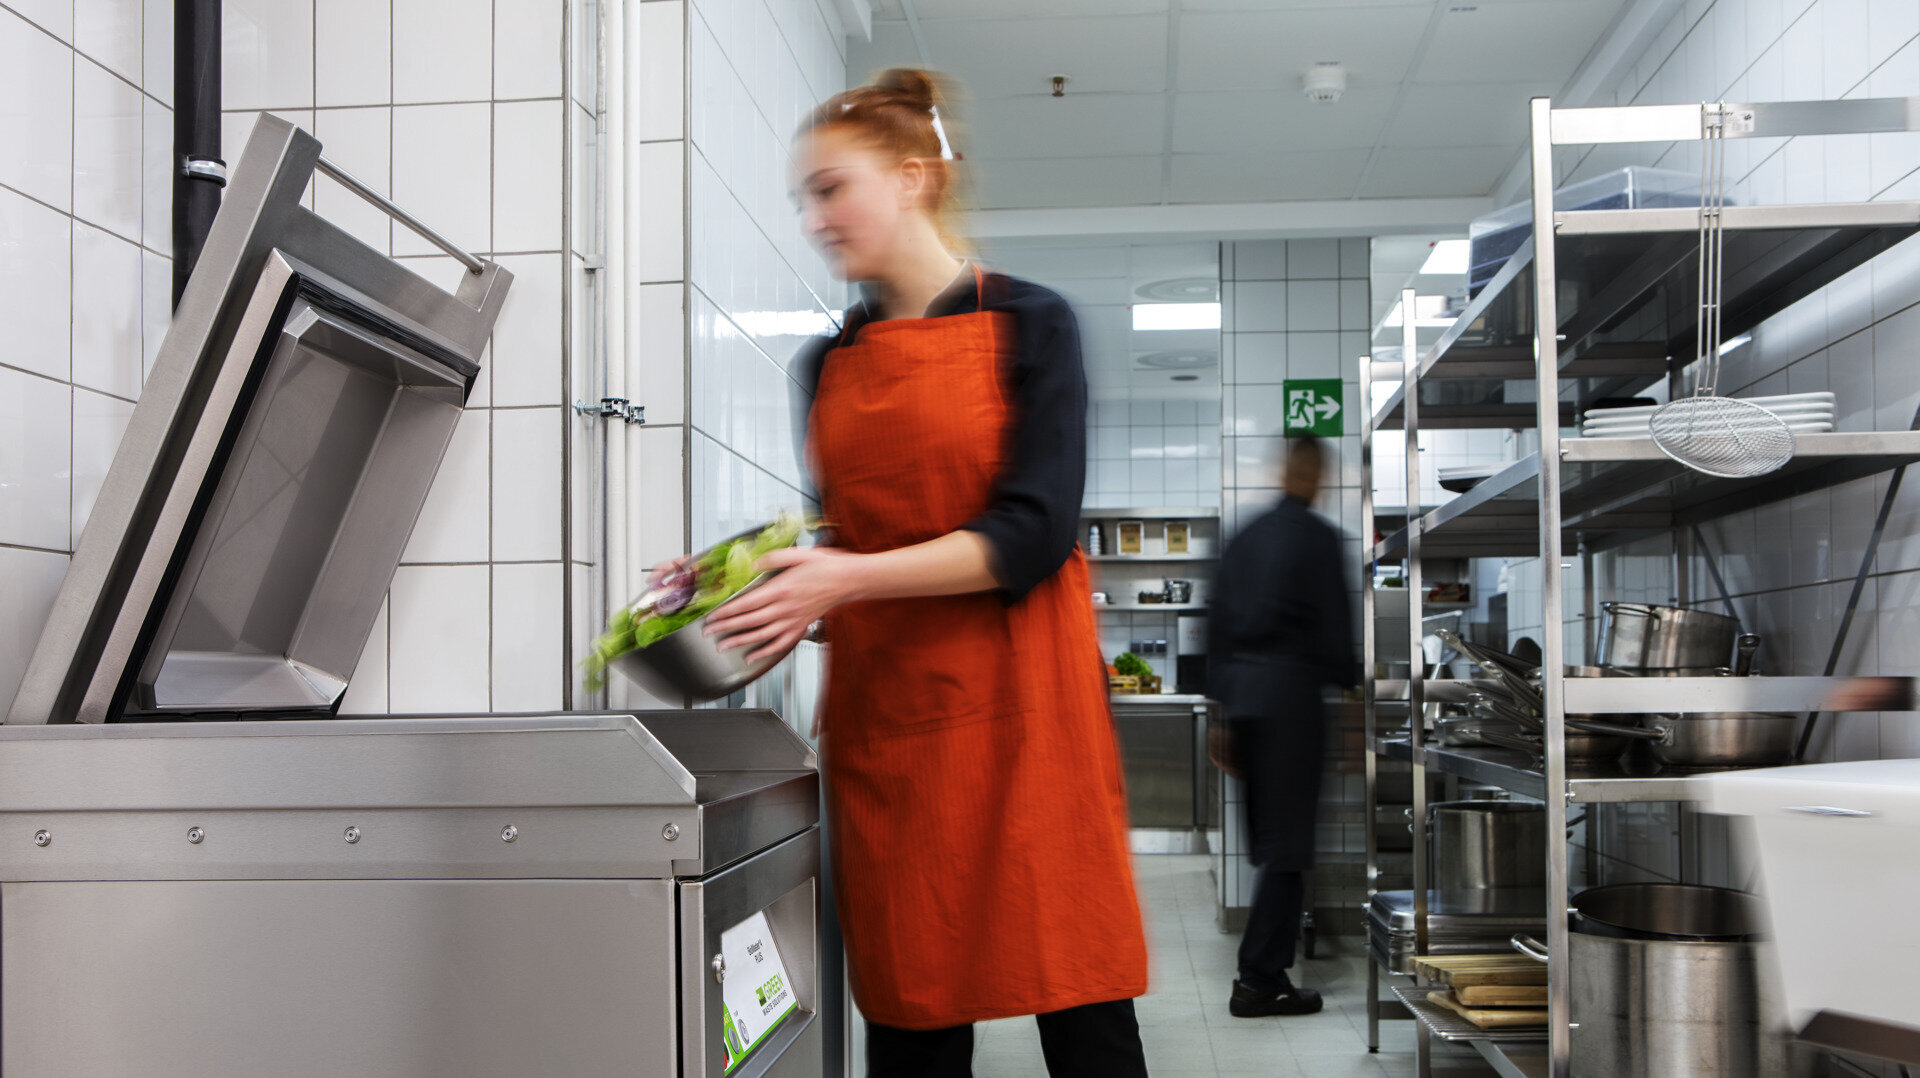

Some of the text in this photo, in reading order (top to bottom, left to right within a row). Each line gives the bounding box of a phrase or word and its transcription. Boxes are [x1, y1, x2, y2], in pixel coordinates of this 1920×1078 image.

[763, 972, 784, 1000] GREEN
[762, 1002, 773, 1016] WASTE
[772, 990, 788, 1008] SOLUTIONS
